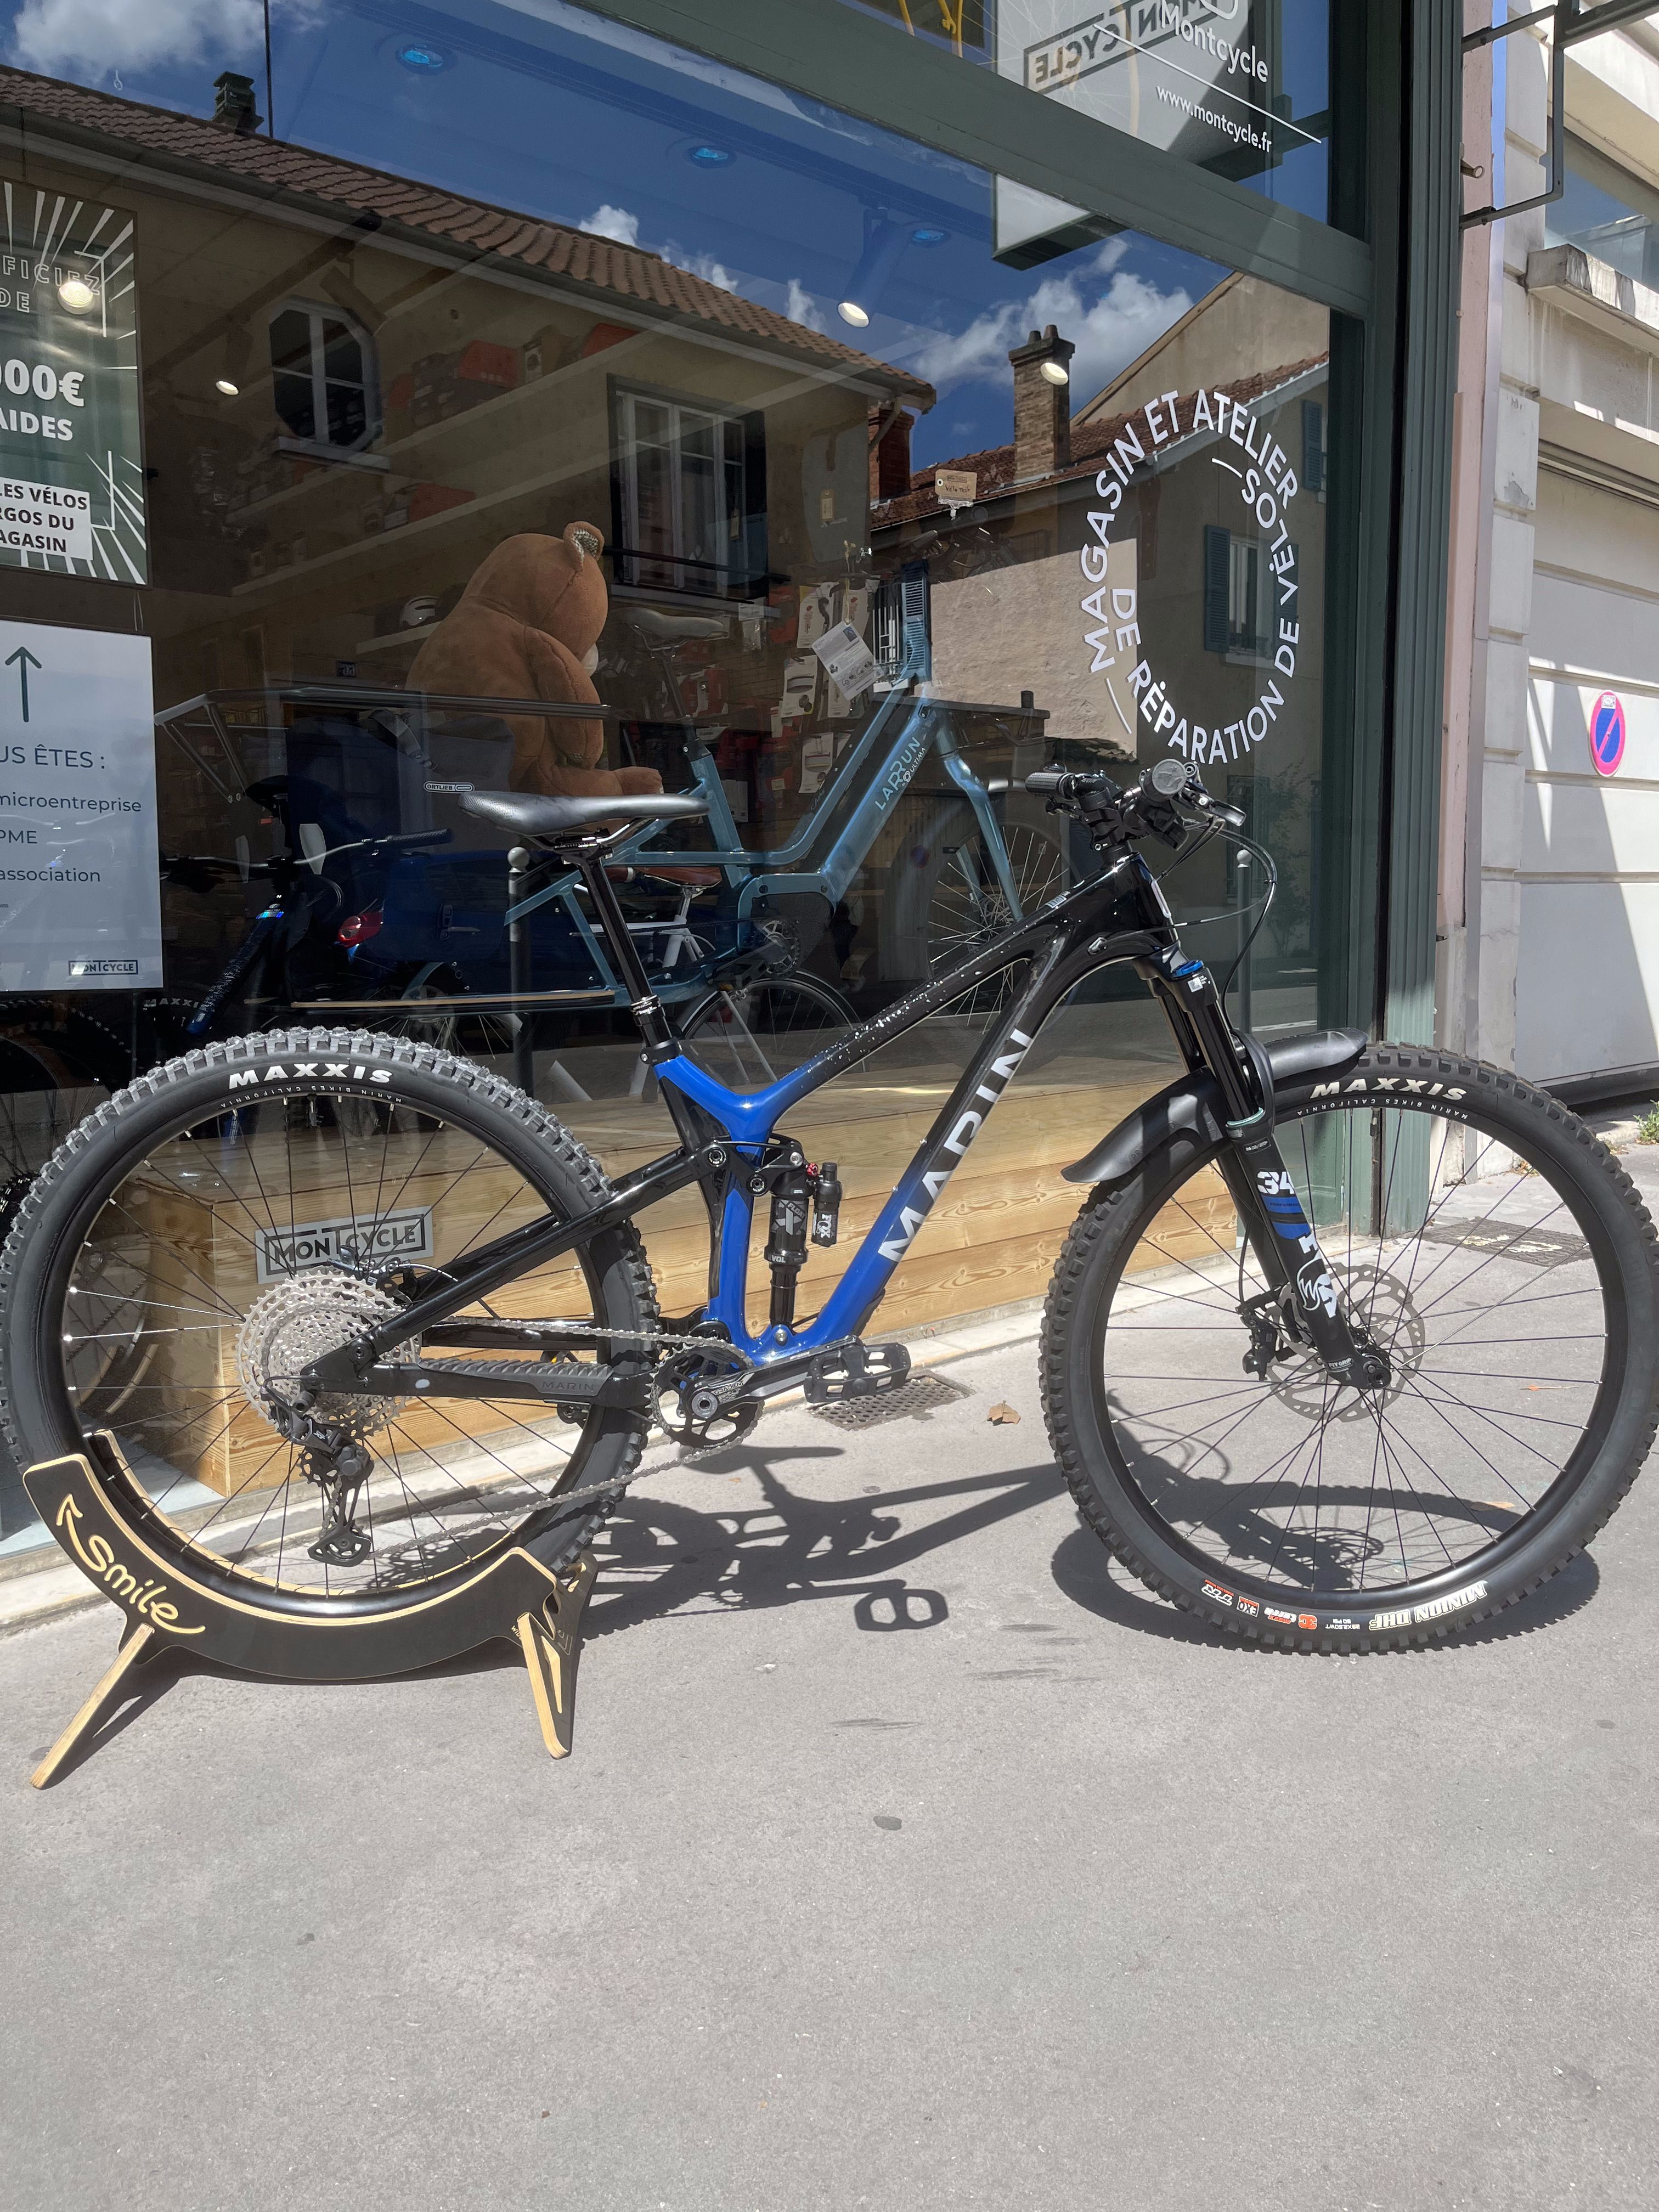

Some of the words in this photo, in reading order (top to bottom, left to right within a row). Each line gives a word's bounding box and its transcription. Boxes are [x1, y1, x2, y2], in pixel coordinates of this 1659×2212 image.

[1161, 0, 1268, 82] Montcycle
[1156, 86, 1272, 153] www.montcycle.fr
[0, 287, 30, 313] DE
[0, 359, 84, 407] 00€
[29, 487, 87, 510] VÉLOS
[48, 514, 74, 531] DU
[1081, 422, 1146, 673] MAGASIN
[1144, 390, 1179, 445] ET
[1192, 389, 1298, 509] ATELIER
[1112, 588, 1142, 652] DE
[1274, 622, 1299, 678] DE
[34, 743, 94, 769] ÊTES
[229, 1063, 393, 1089] MAXXIS
[220, 1086, 302, 1109] CALIFORNIA
[361, 1088, 402, 1103] MARIN
[1310, 1077, 1468, 1101] MAXXIS
[1296, 1098, 1376, 1116] CALIFORNIA
[1385, 1098, 1423, 1107] BIKES
[1430, 1104, 1469, 1120] MARIN
[878, 1028, 1034, 1262] MARIN
[1256, 1171, 1295, 1195] 34
[817, 1214, 833, 1239] FOX
[542, 1381, 594, 1391] MARIN
[713, 1380, 744, 1396] GRADIENT
[65, 1509, 206, 1634] Smile
[1414, 1581, 1488, 1623] MINION
[1368, 1609, 1412, 1631] DHF
